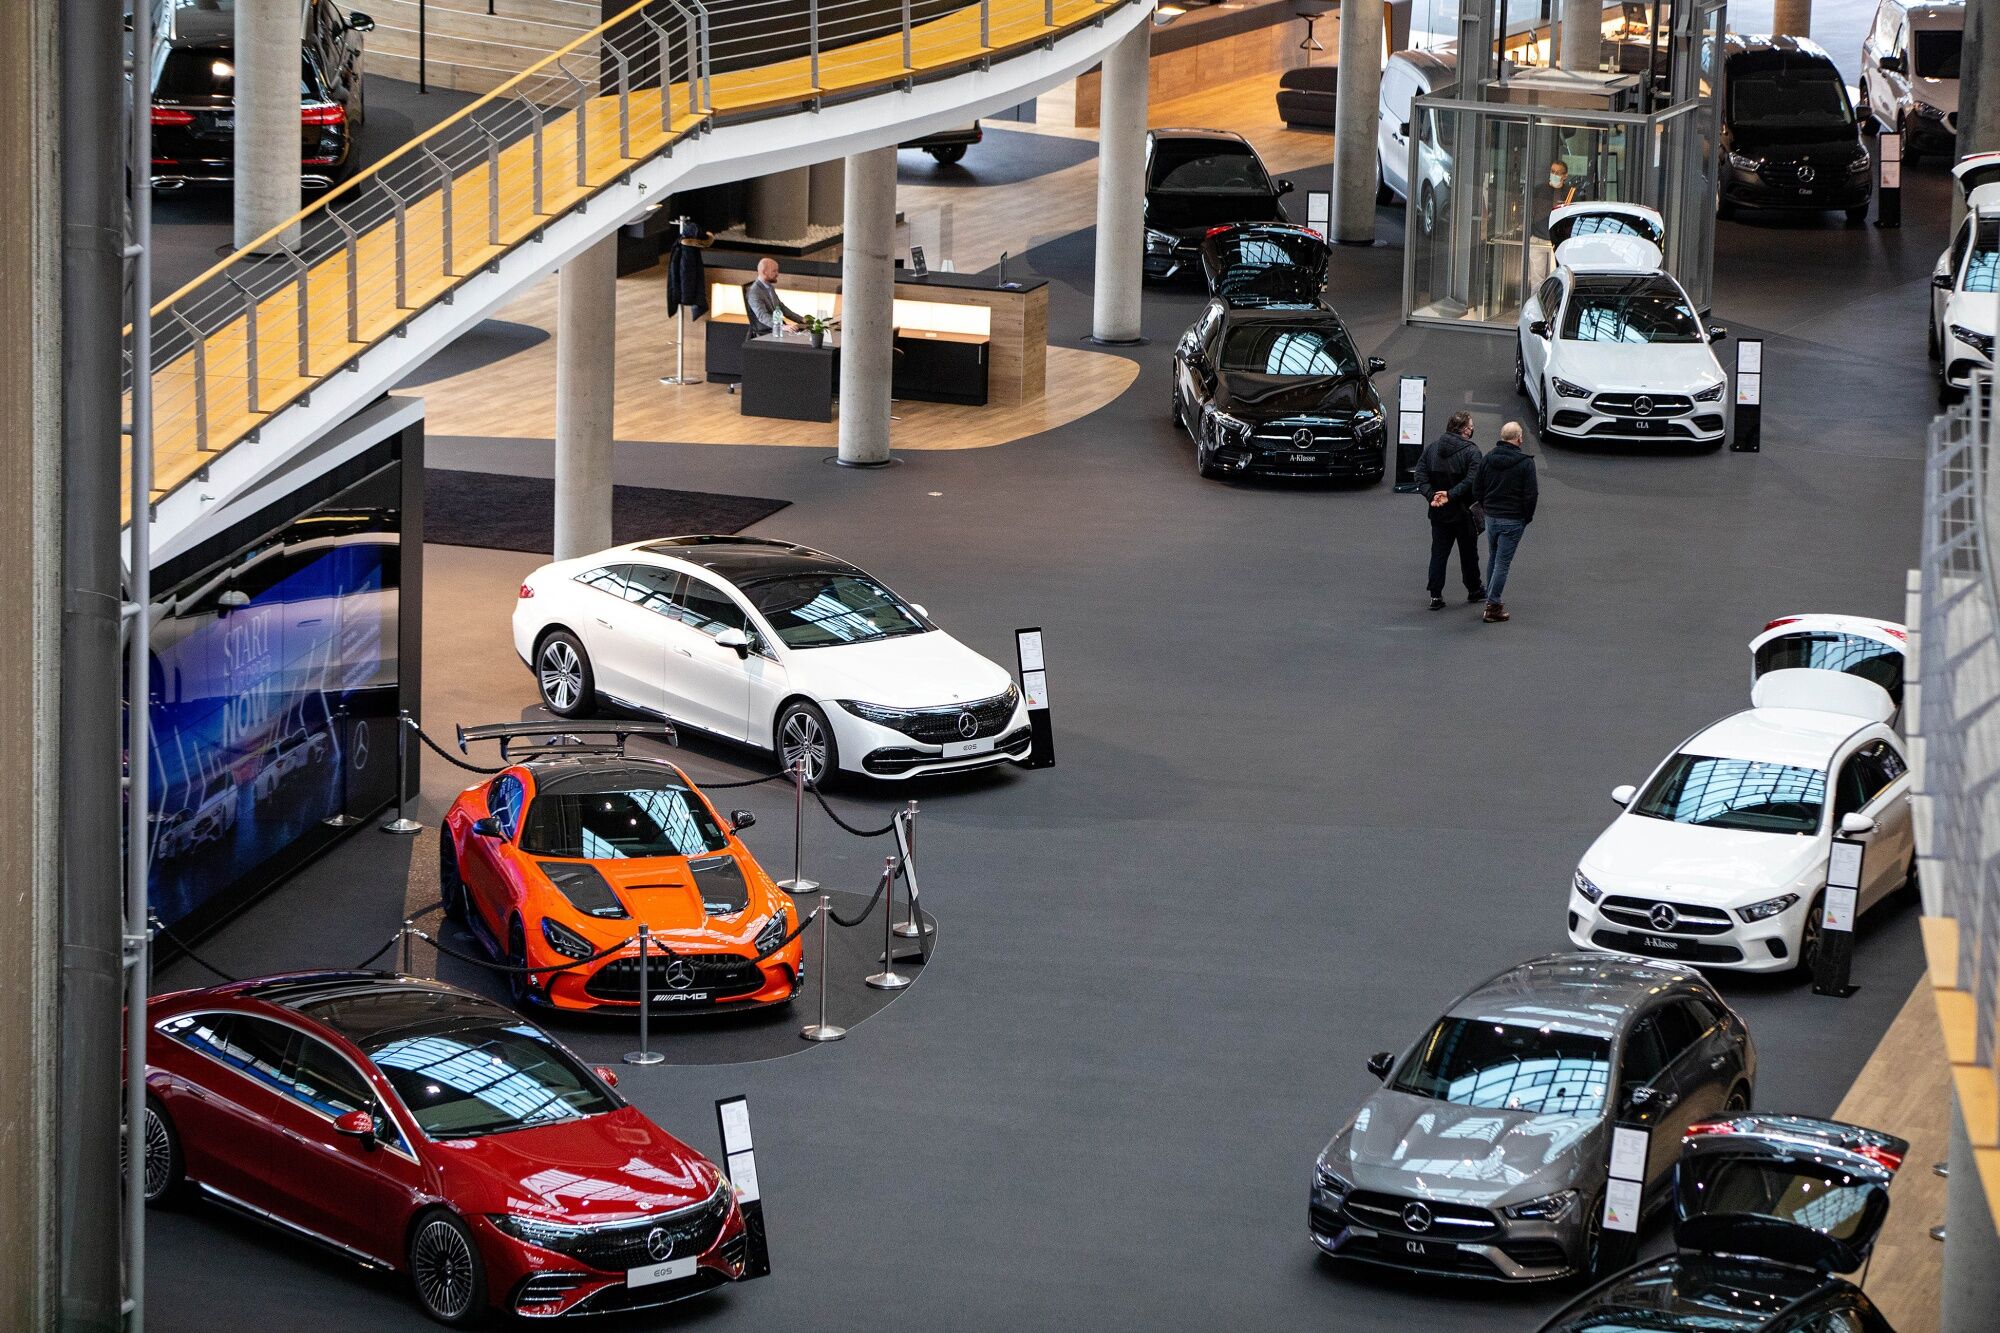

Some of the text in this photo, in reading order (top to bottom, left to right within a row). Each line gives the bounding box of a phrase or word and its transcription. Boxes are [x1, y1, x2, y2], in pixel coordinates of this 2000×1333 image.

[1636, 421, 1649, 429] CLA
[223, 608, 271, 677] START
[223, 677, 271, 748] NOW
[1643, 936, 1679, 950] A-Klasse
[670, 992, 708, 1001] AMG
[1406, 1240, 1426, 1254] CLA
[653, 1266, 673, 1278] EQS
